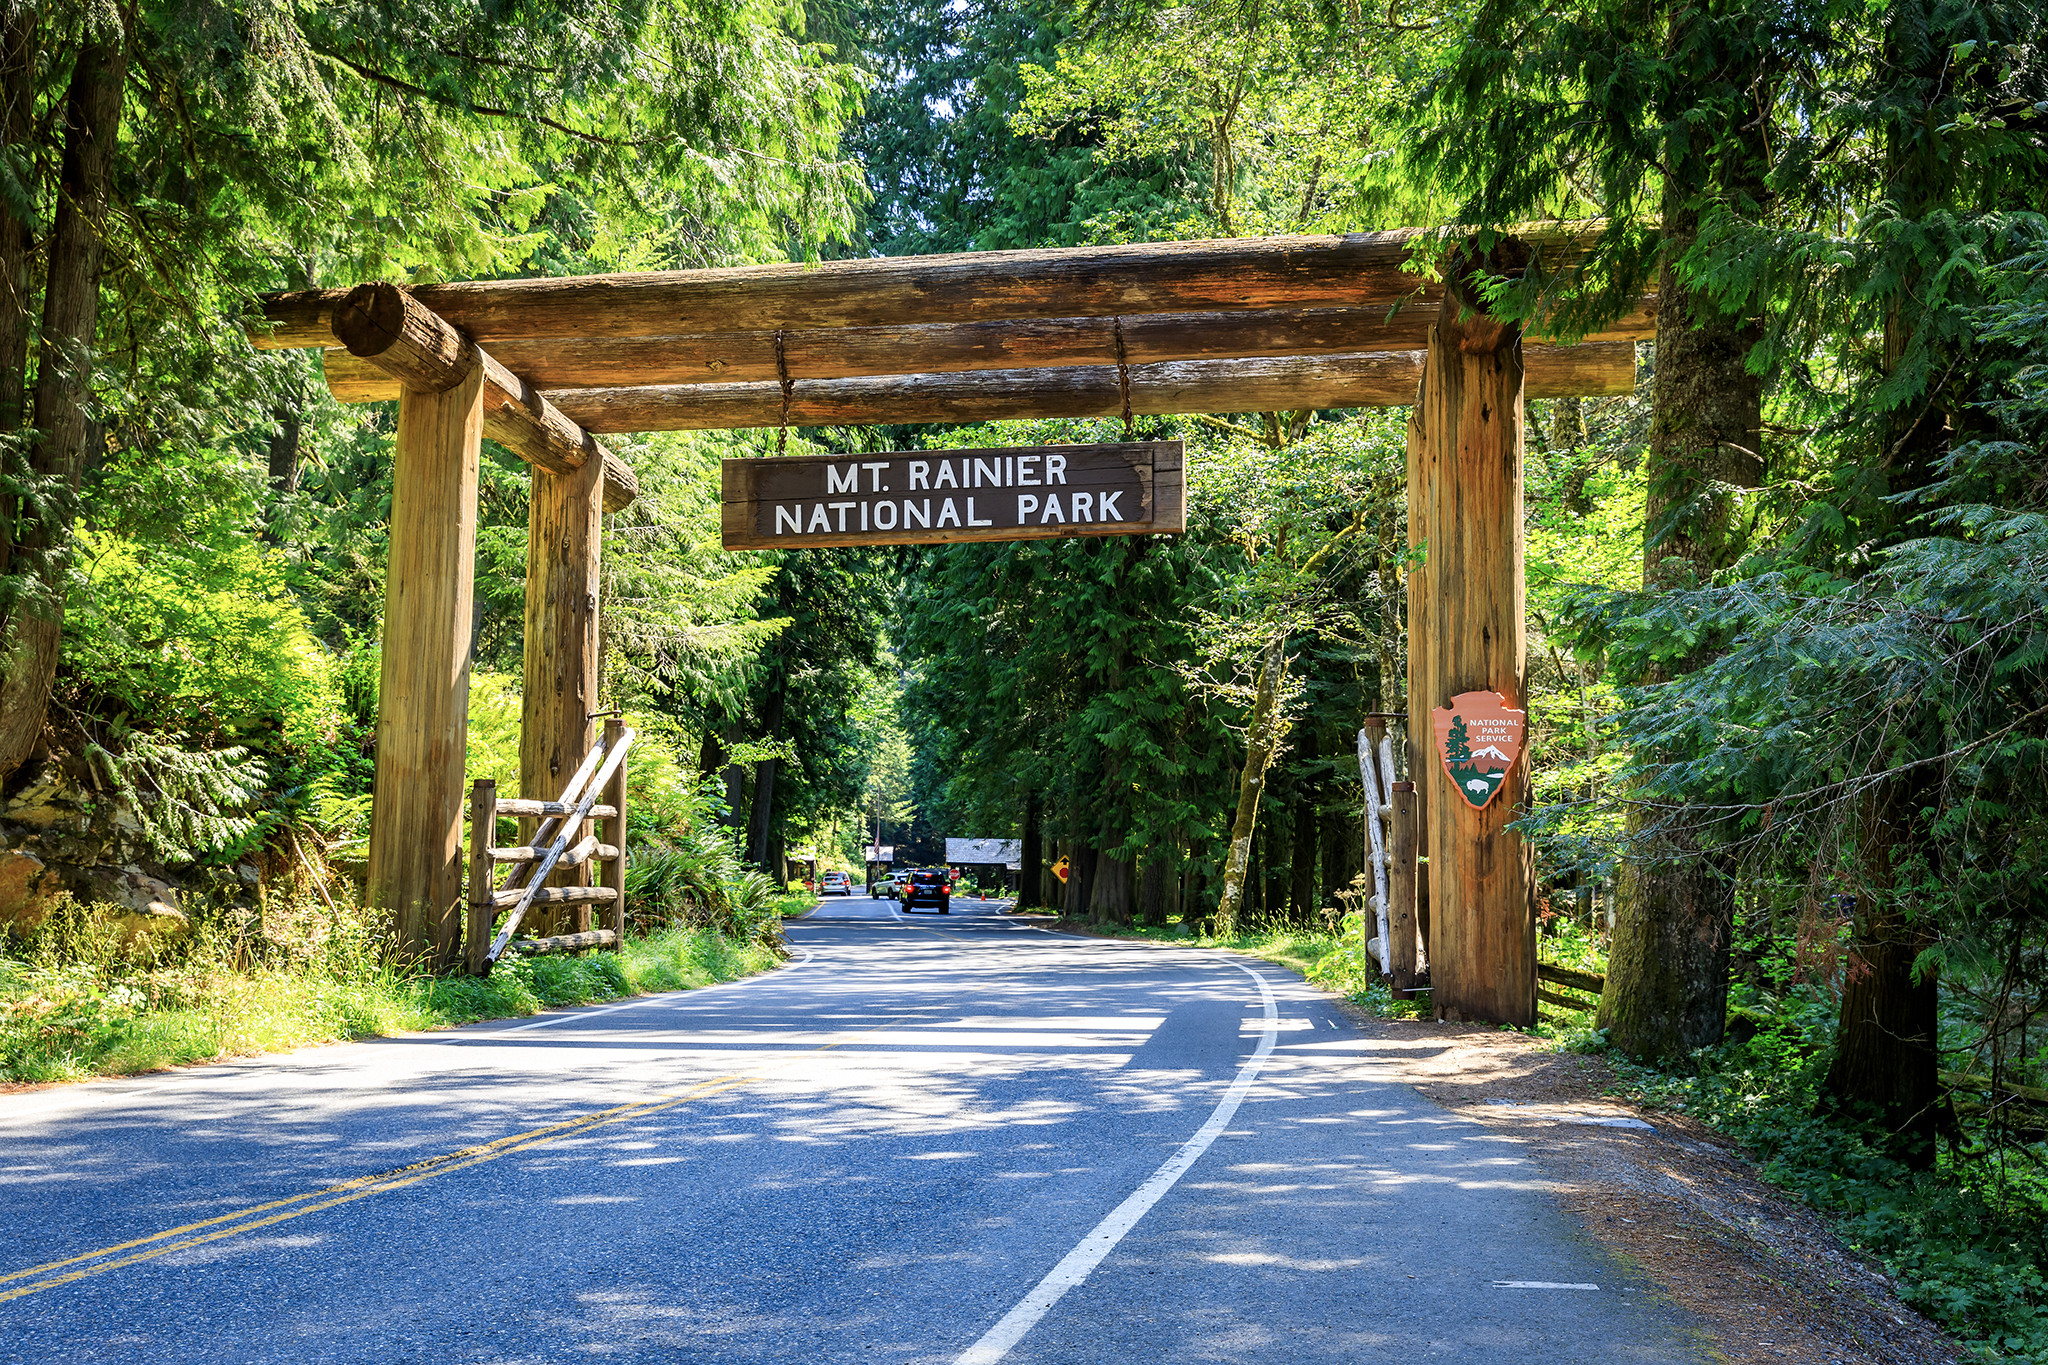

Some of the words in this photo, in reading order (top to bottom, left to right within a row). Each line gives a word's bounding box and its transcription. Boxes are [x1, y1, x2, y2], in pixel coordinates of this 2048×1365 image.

[827, 462, 890, 494] MT.
[909, 455, 1067, 491] RAINIER
[775, 497, 993, 535] NATIONAL
[1018, 491, 1125, 525] PARK
